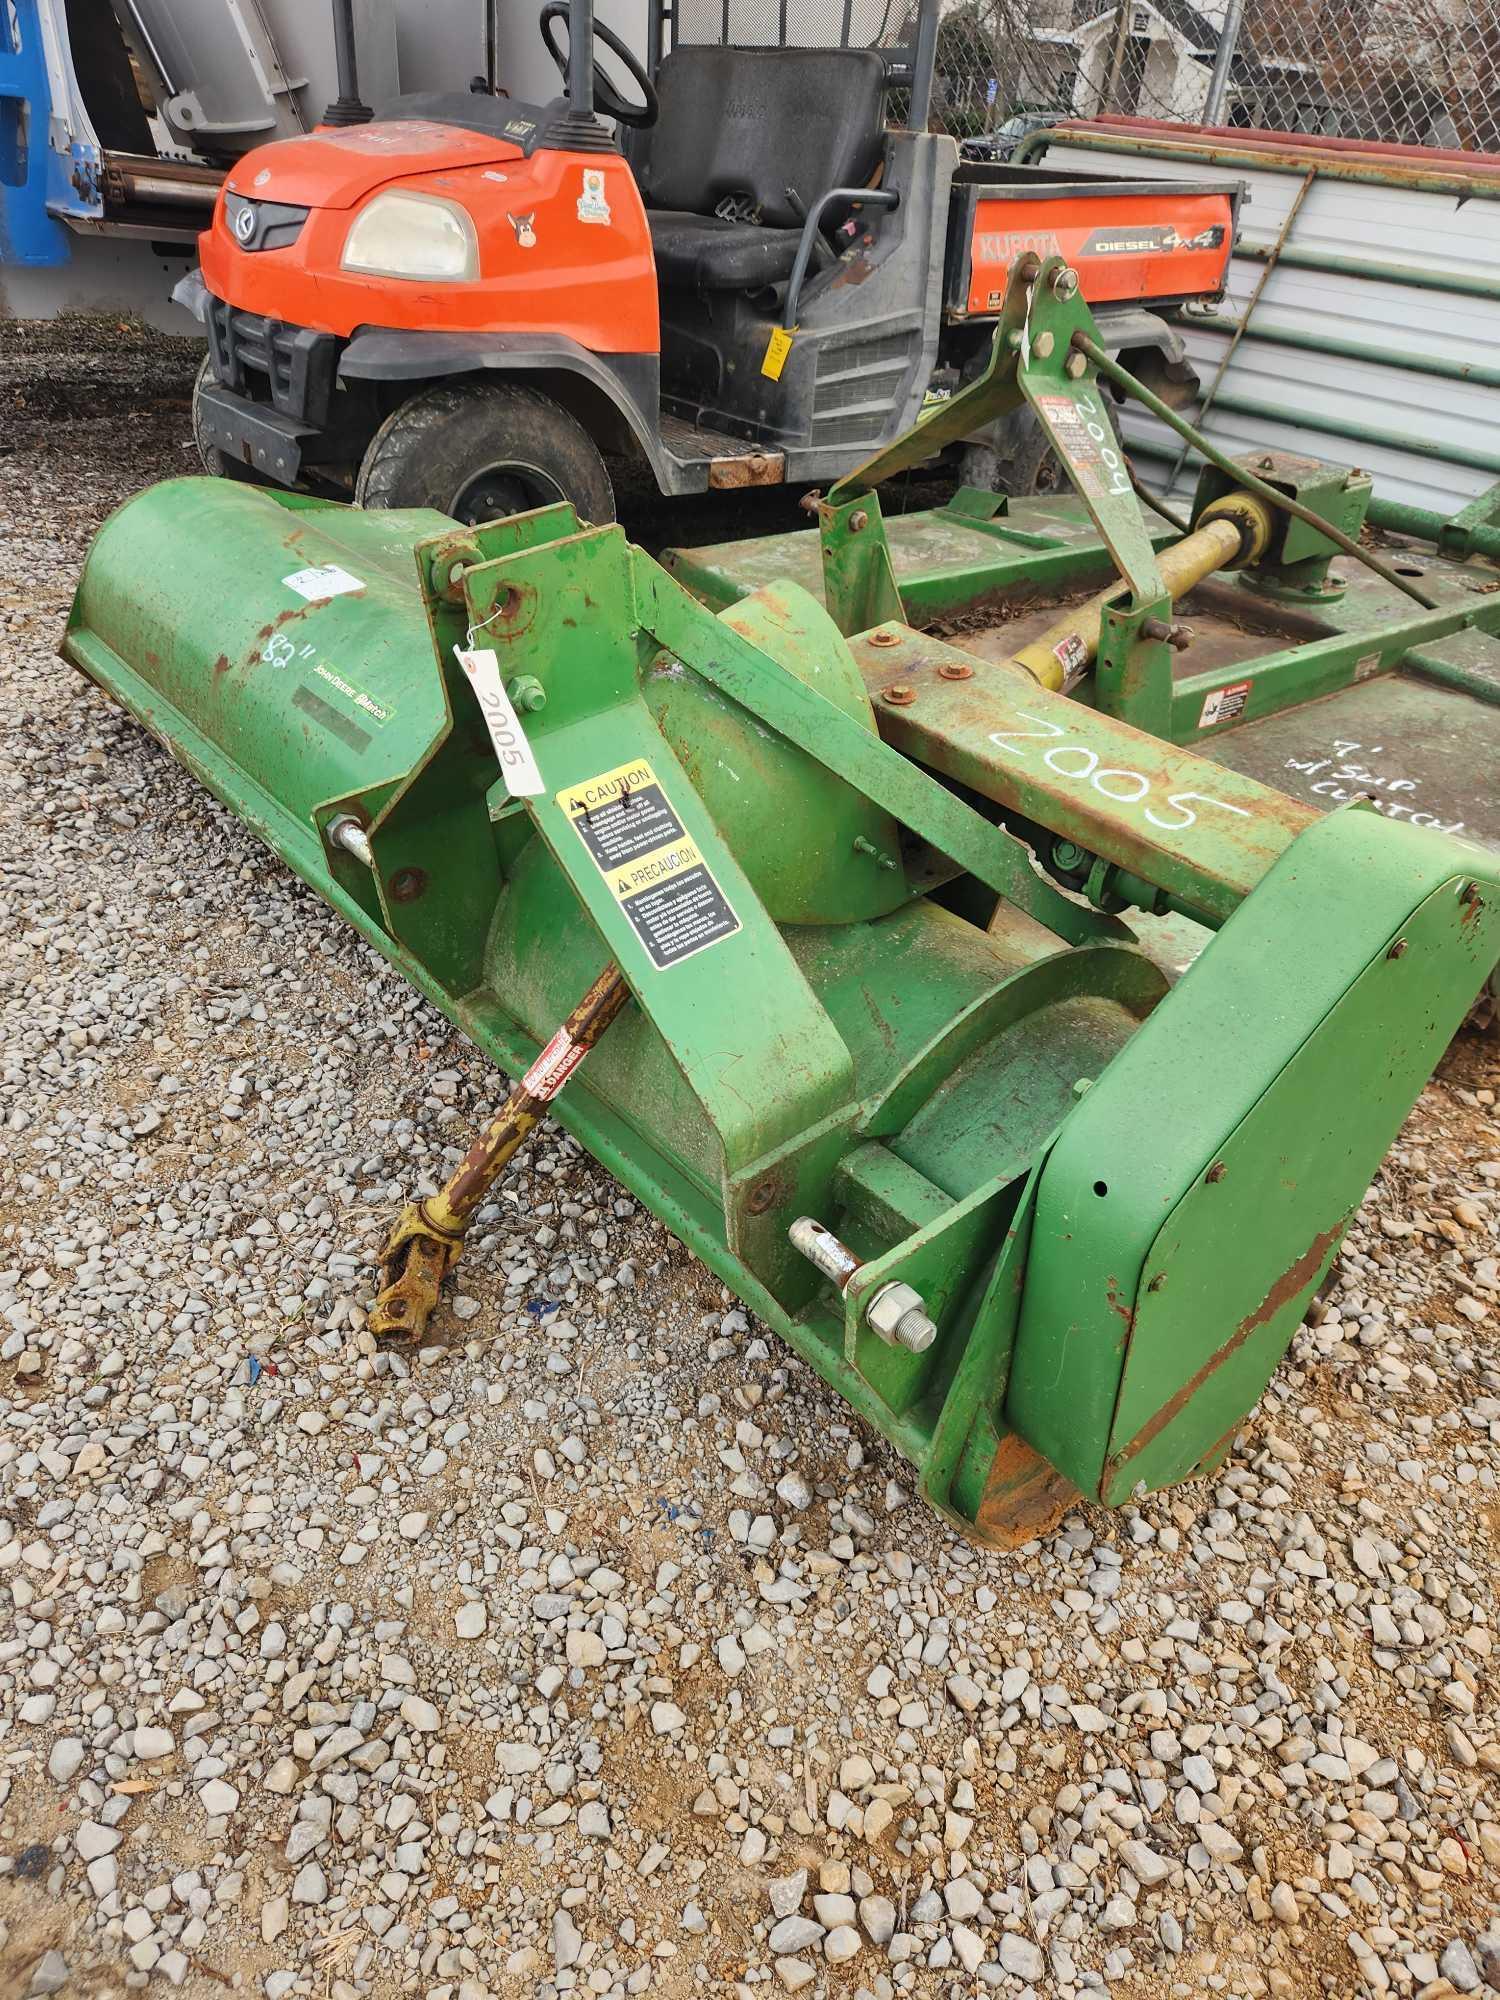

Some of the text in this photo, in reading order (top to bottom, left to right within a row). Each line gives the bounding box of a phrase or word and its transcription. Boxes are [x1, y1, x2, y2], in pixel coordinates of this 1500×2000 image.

[980, 232, 1062, 262] KUBOTA
[1095, 240, 1160, 252] DIESEL
[1075, 393, 1131, 496] 2004
[313, 664, 333, 683] JOHN
[331, 675, 357, 698] DEERE
[482, 692, 526, 766] 2005
[585, 767, 650, 803] CAUTION
[988, 711, 1253, 830] 2005
[1310, 781, 1465, 834] CLTCH
[630, 847, 697, 886] PRECAUCION
[546, 1045, 585, 1085] DANGER
